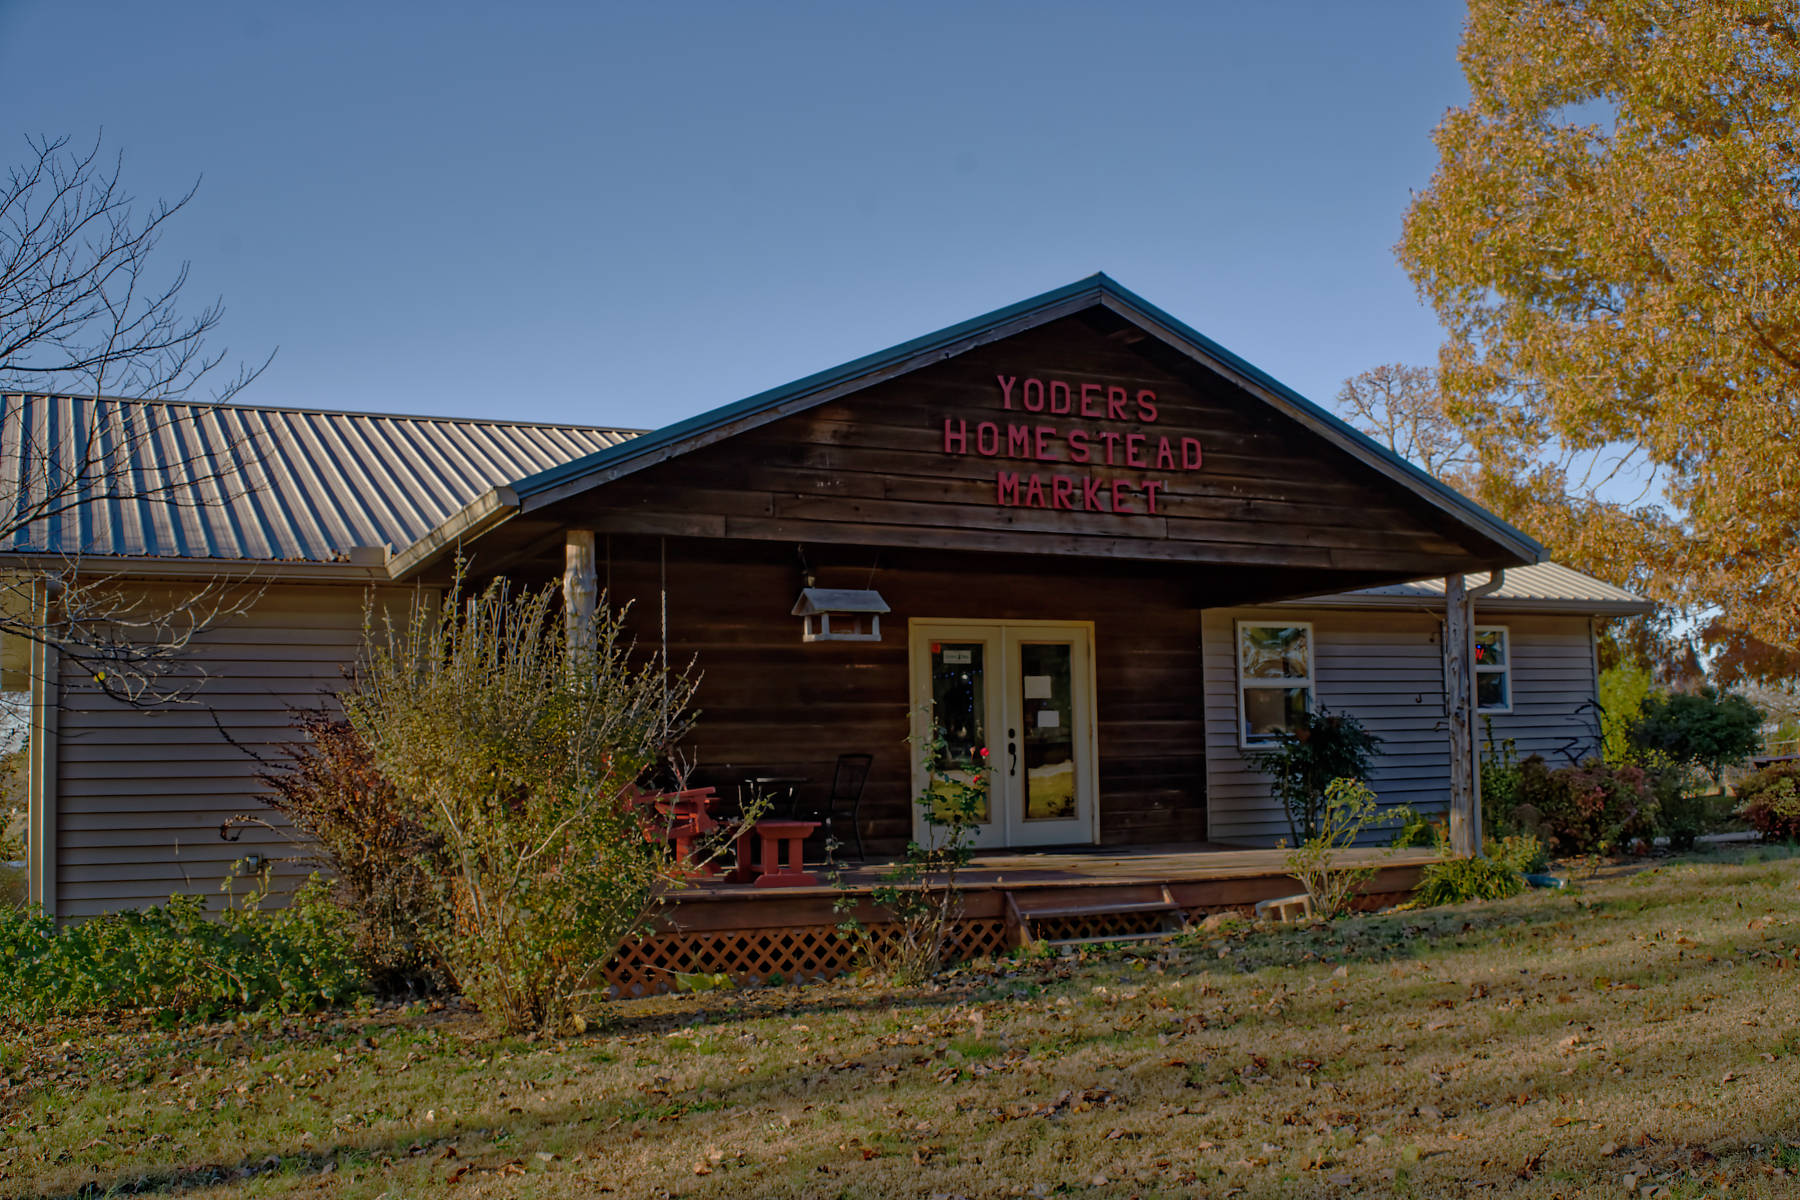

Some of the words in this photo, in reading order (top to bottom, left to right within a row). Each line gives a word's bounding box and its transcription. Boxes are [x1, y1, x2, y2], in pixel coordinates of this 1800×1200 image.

[997, 375, 1158, 422] YODERS
[944, 419, 1202, 470] HOMESTEAD
[997, 472, 1162, 514] MARKET
